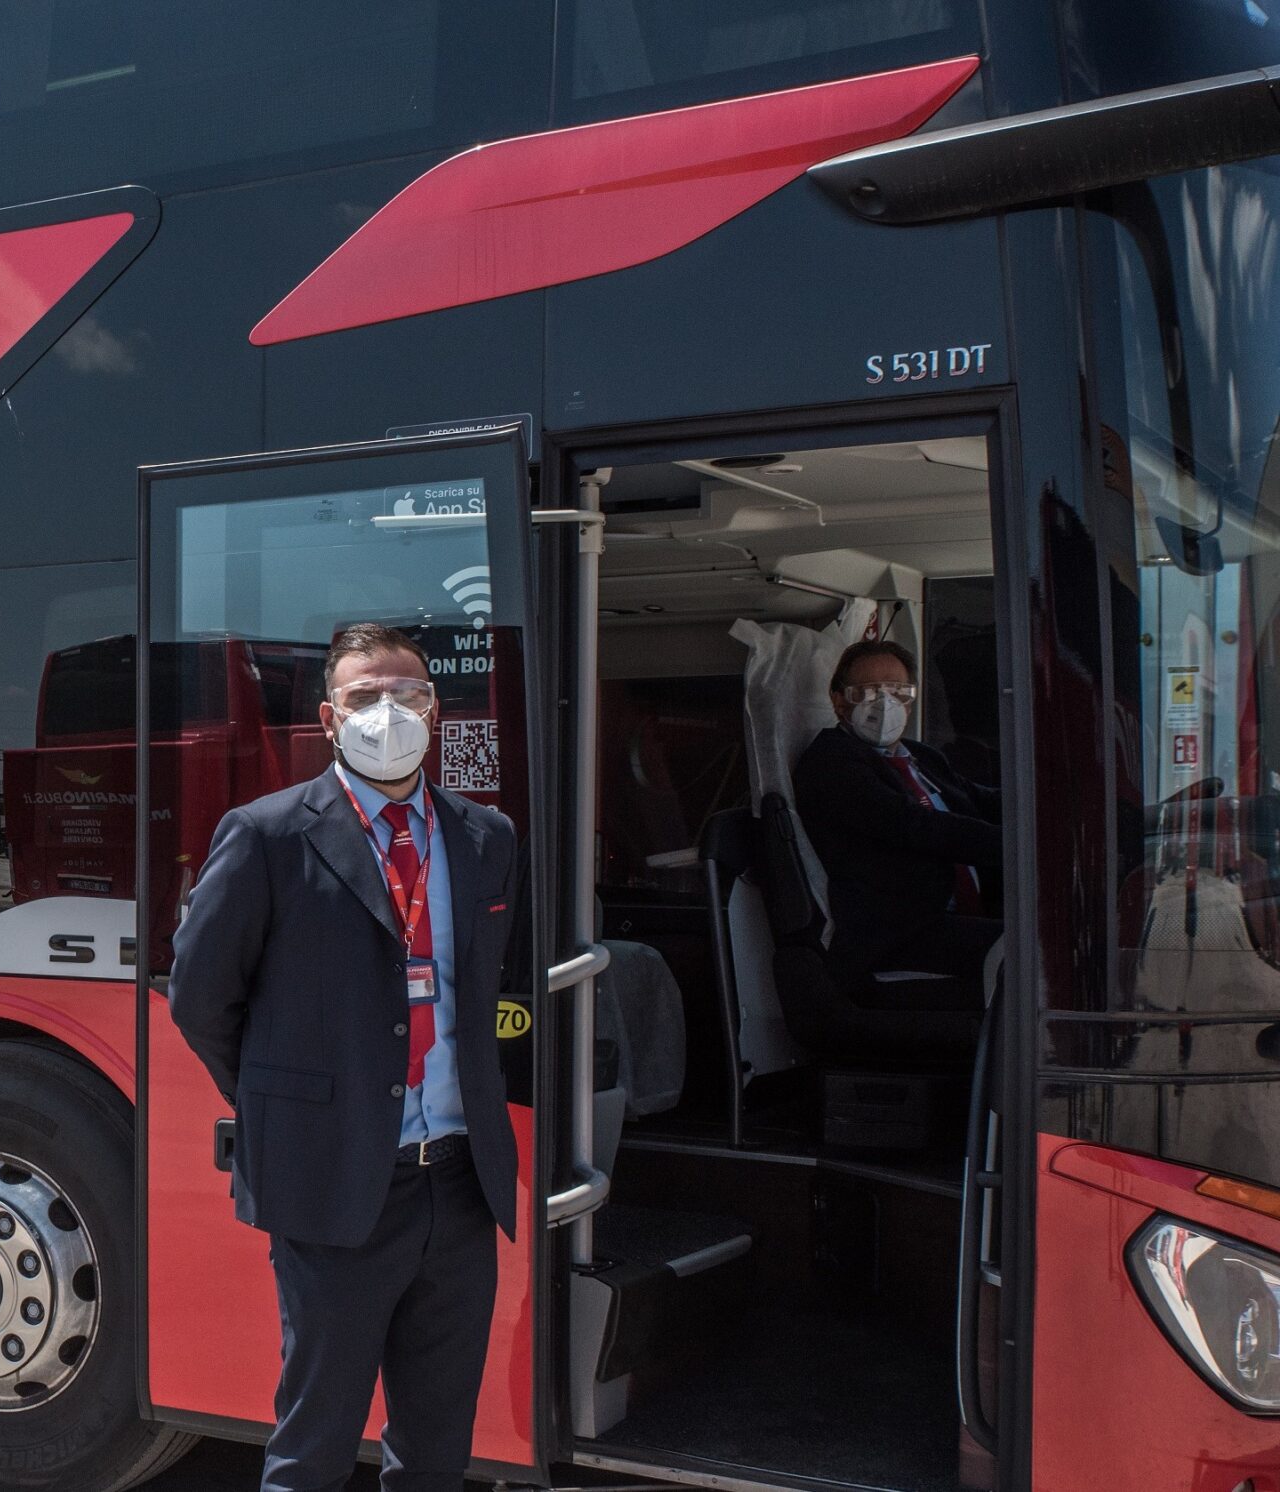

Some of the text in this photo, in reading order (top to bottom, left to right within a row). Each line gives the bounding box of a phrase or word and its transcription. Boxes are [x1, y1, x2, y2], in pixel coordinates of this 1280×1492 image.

[866, 344, 992, 384] S 531 DT
[424, 487, 480, 499] Scarica su
[454, 634, 494, 650] WI-F
[429, 656, 496, 674] ON BOA
[497, 1009, 526, 1031] 70
